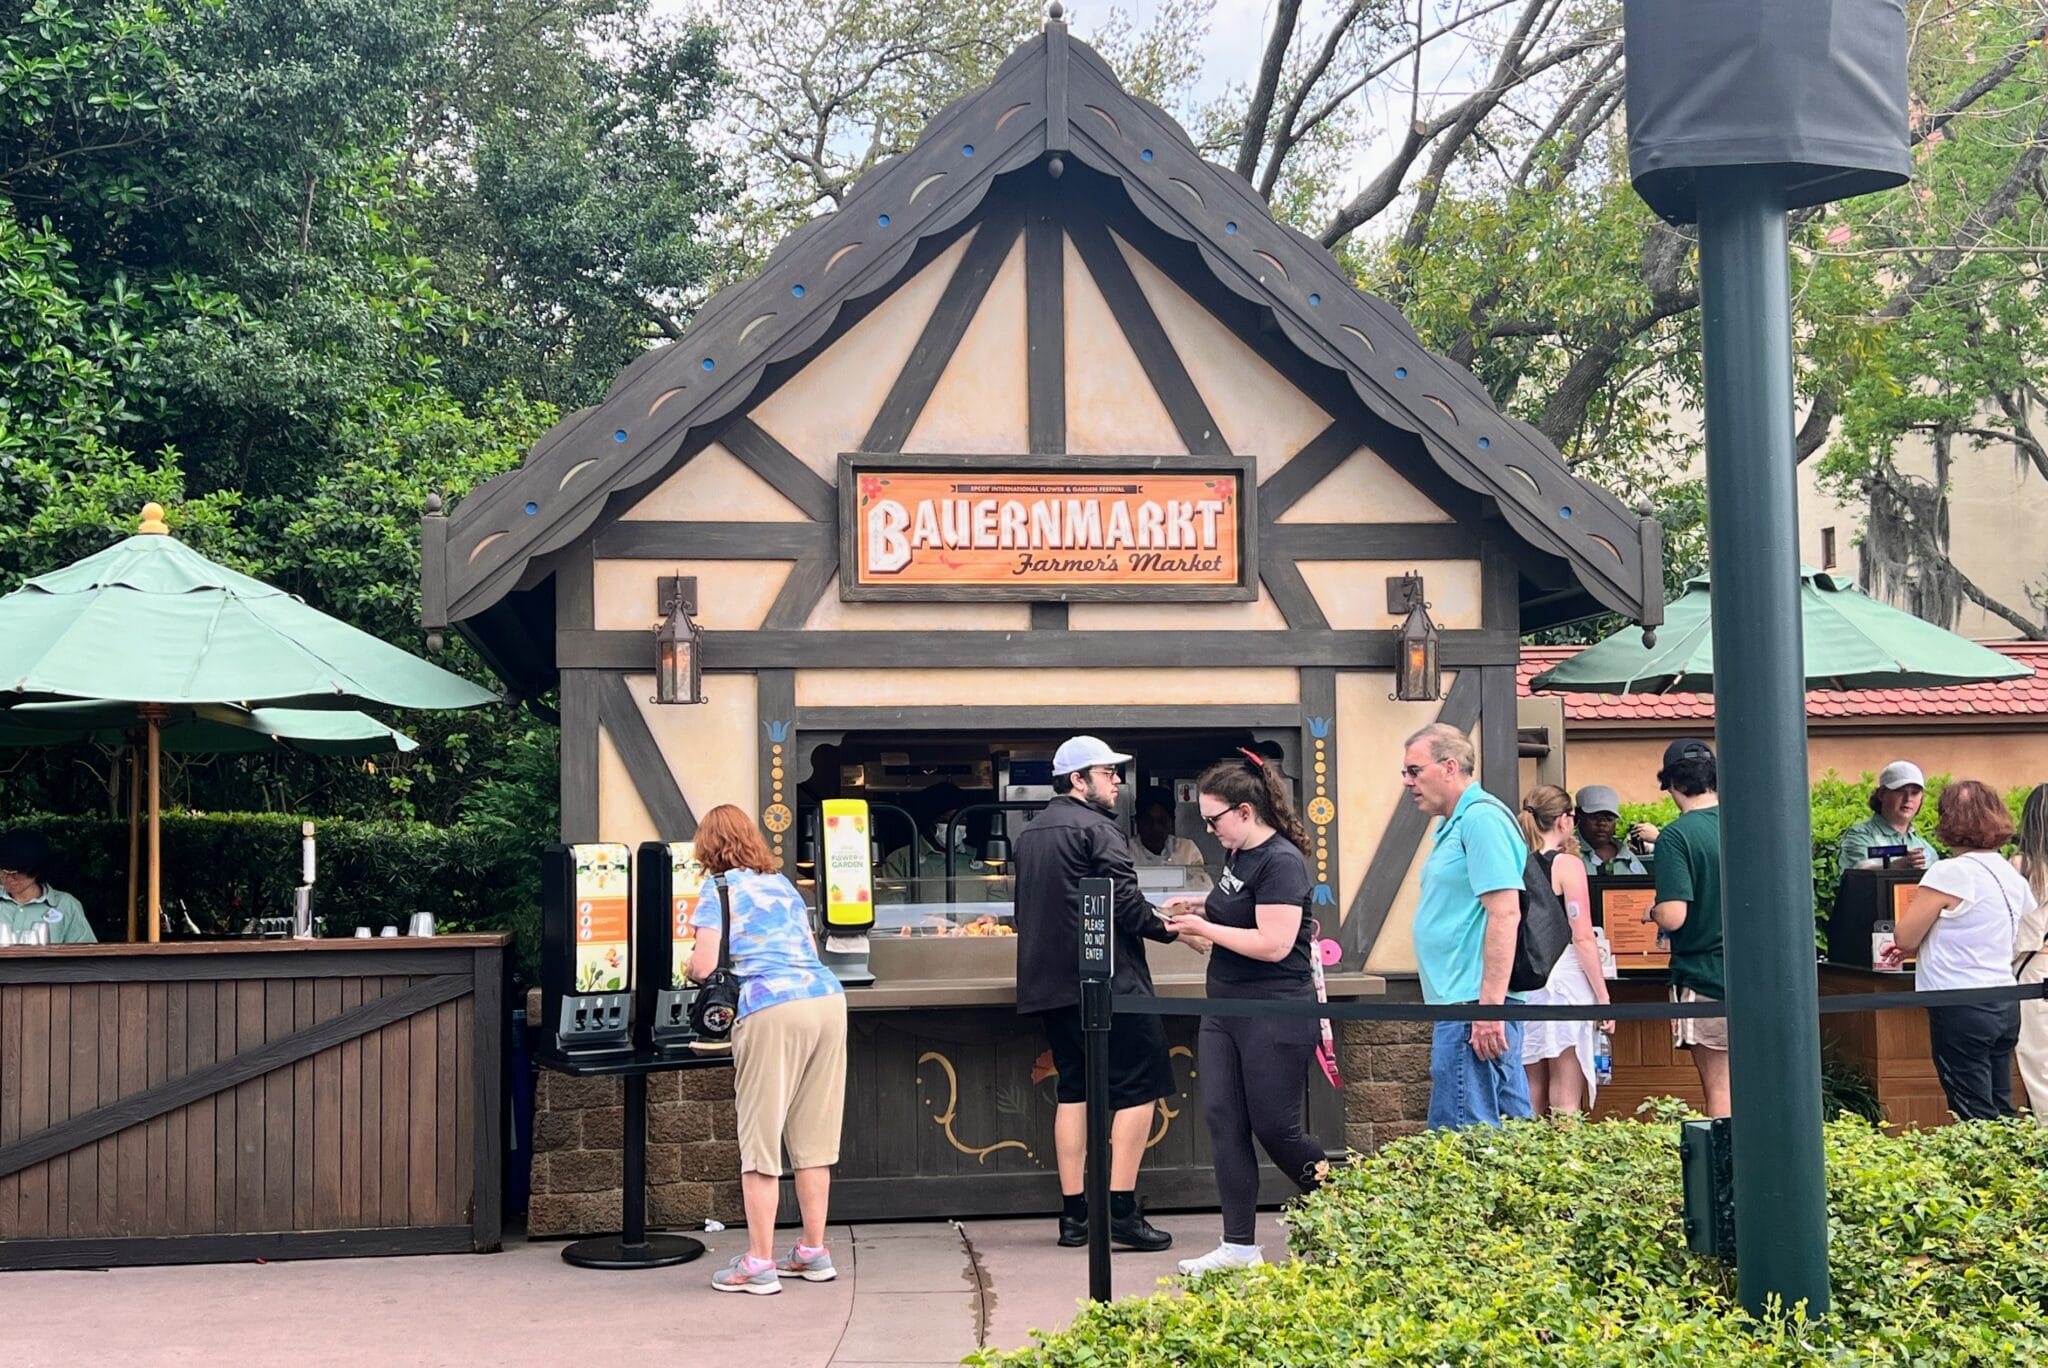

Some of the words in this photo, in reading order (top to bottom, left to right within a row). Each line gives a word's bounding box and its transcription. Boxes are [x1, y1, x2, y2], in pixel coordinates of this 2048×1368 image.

[867, 499, 1225, 574] BAUERNMARKT
[1012, 552, 1119, 575] Farmer's
[1128, 553, 1223, 573] Market
[1083, 895, 1106, 916] EXIT
[1084, 919, 1105, 931] PLEASE
[1084, 933, 1093, 945] DO
[1094, 934, 1105, 945] NOT
[1085, 947, 1104, 960] ENTER
